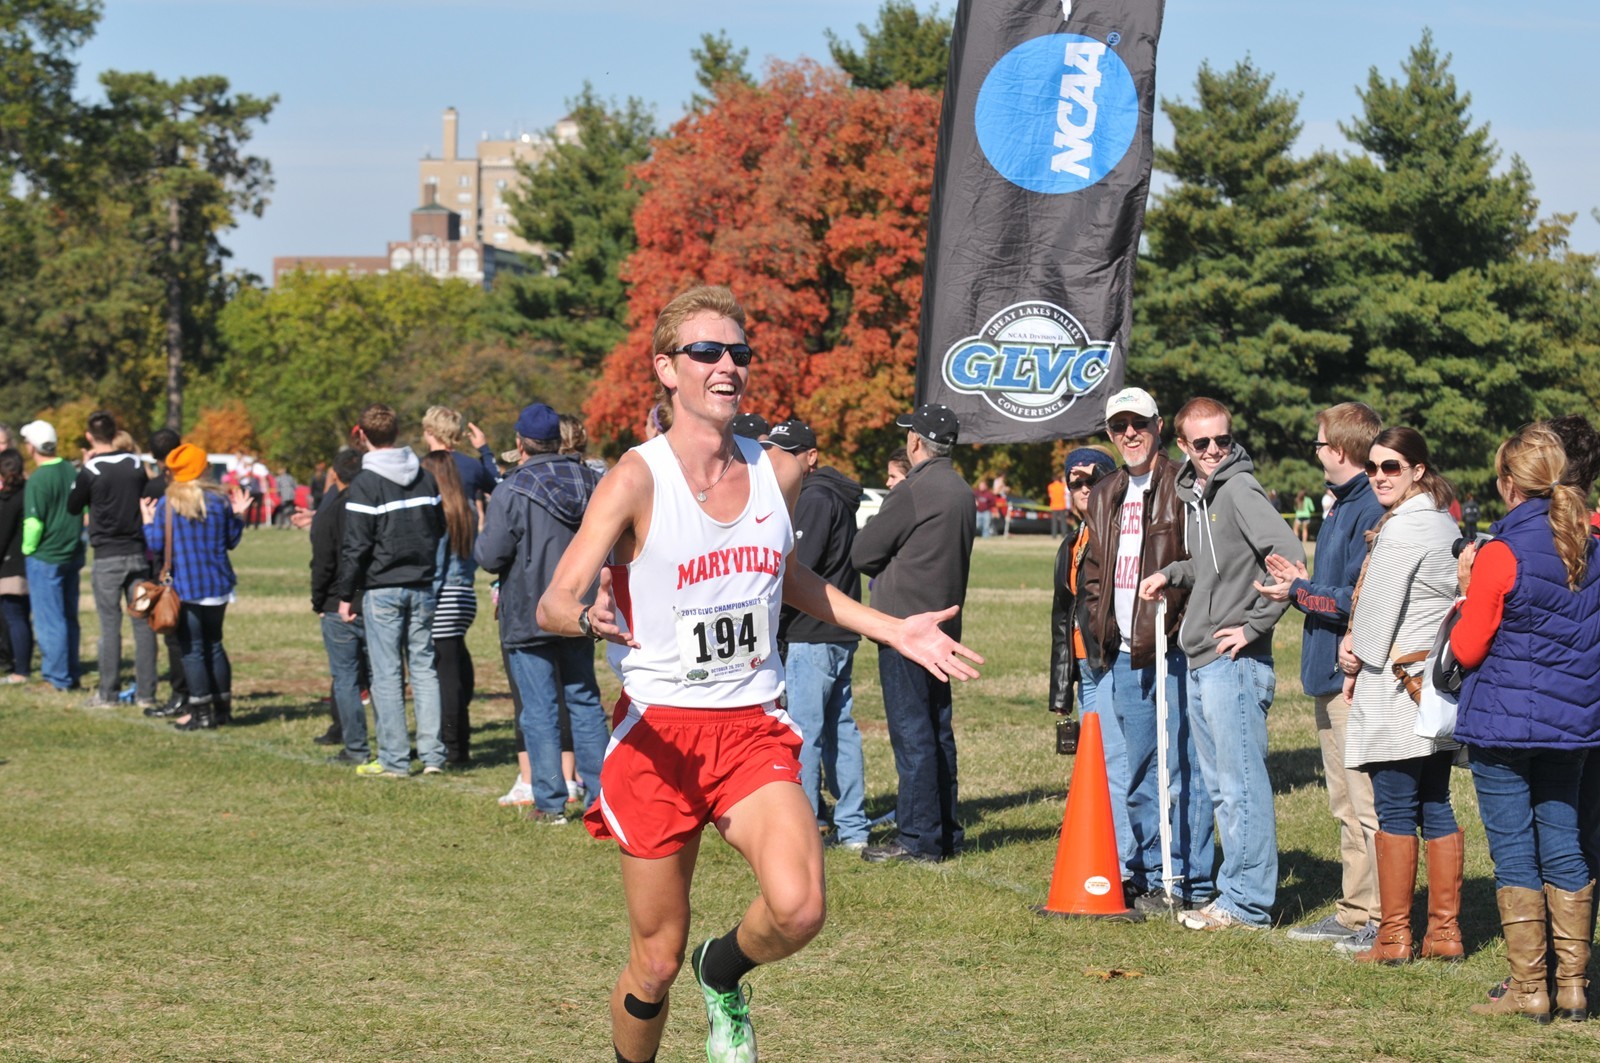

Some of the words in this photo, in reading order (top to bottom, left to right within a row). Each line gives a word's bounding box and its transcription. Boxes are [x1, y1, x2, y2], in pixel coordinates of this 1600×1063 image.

[1051, 42, 1107, 180] NCAA
[988, 311, 1016, 336] GREAT
[1019, 307, 1051, 317] LAKES
[1053, 311, 1082, 340] VALLEY
[949, 341, 1113, 392] GLVC
[997, 397, 1065, 417] CONFERENCE
[677, 545, 783, 590] MARYVILLE
[681, 609, 697, 617] 2013
[697, 607, 713, 616] GLVC
[693, 612, 757, 664] 194
